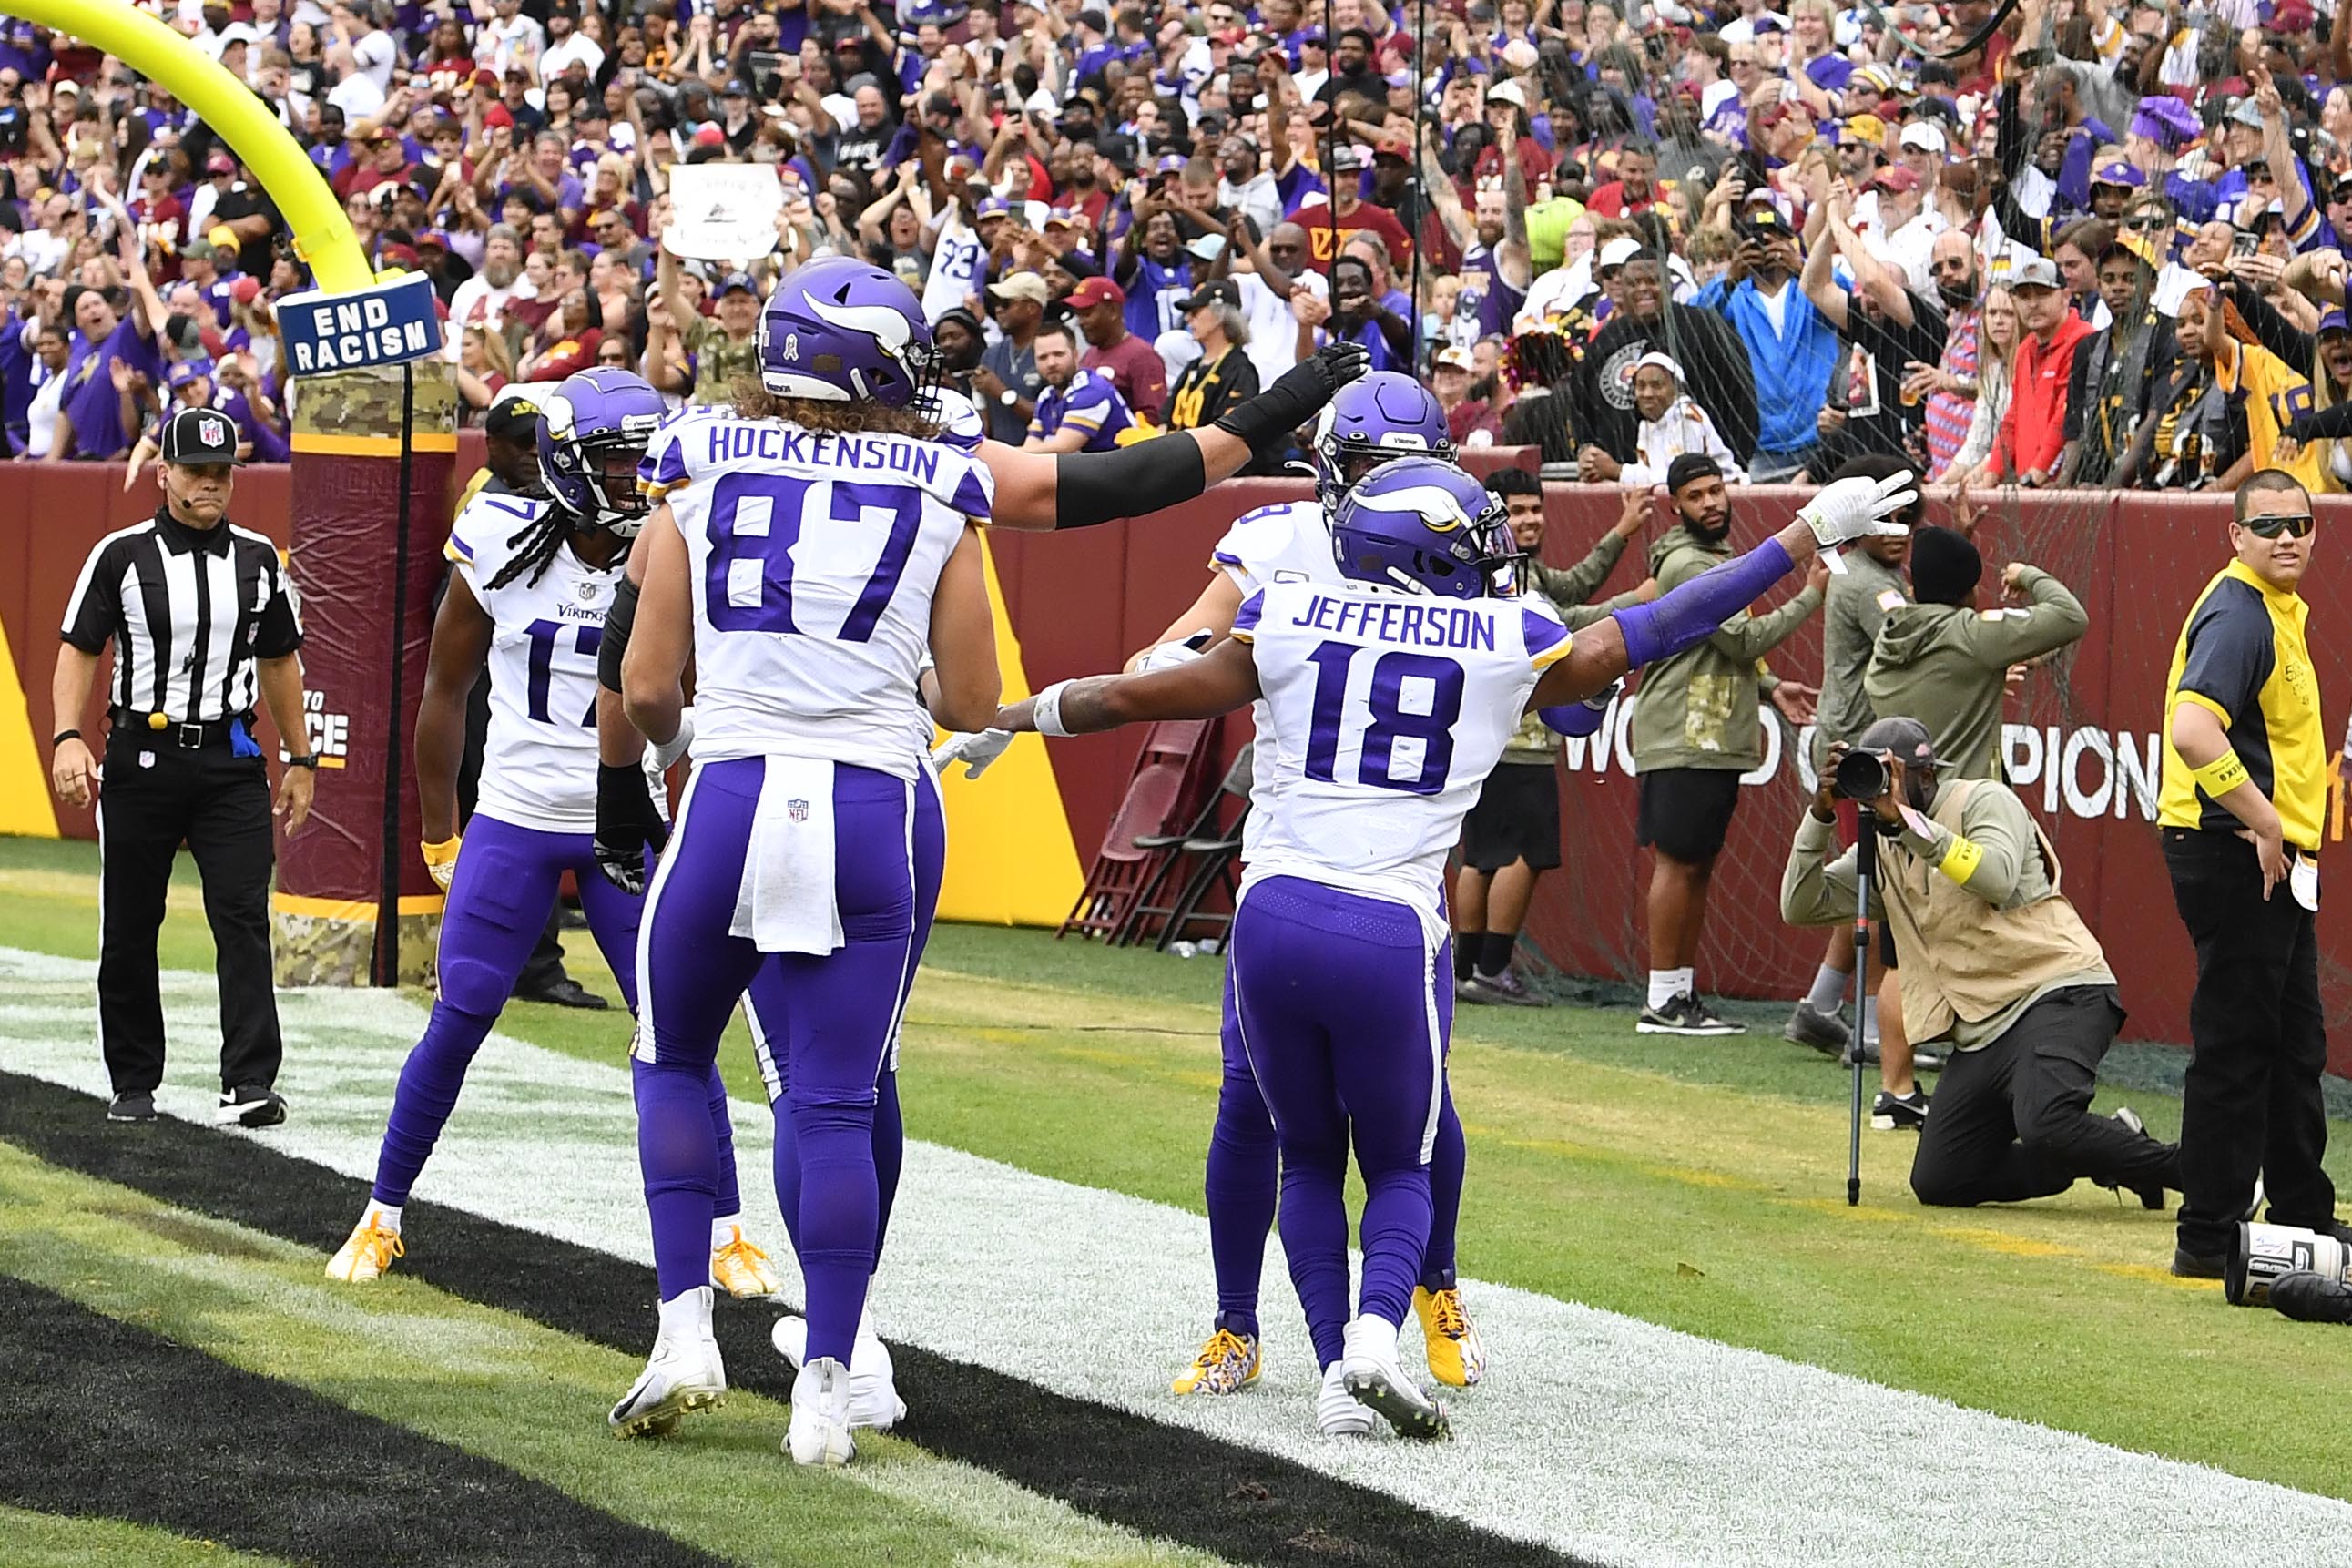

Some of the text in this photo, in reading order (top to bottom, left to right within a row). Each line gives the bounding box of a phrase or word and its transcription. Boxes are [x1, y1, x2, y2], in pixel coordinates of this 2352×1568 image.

[294, 321, 427, 371] RACISM
[313, 298, 388, 337] END
[709, 426, 940, 485] HOCKENSON
[705, 472, 922, 643] 87
[1292, 595, 1495, 651] JEFFERSON
[1304, 640, 1465, 795] 18
